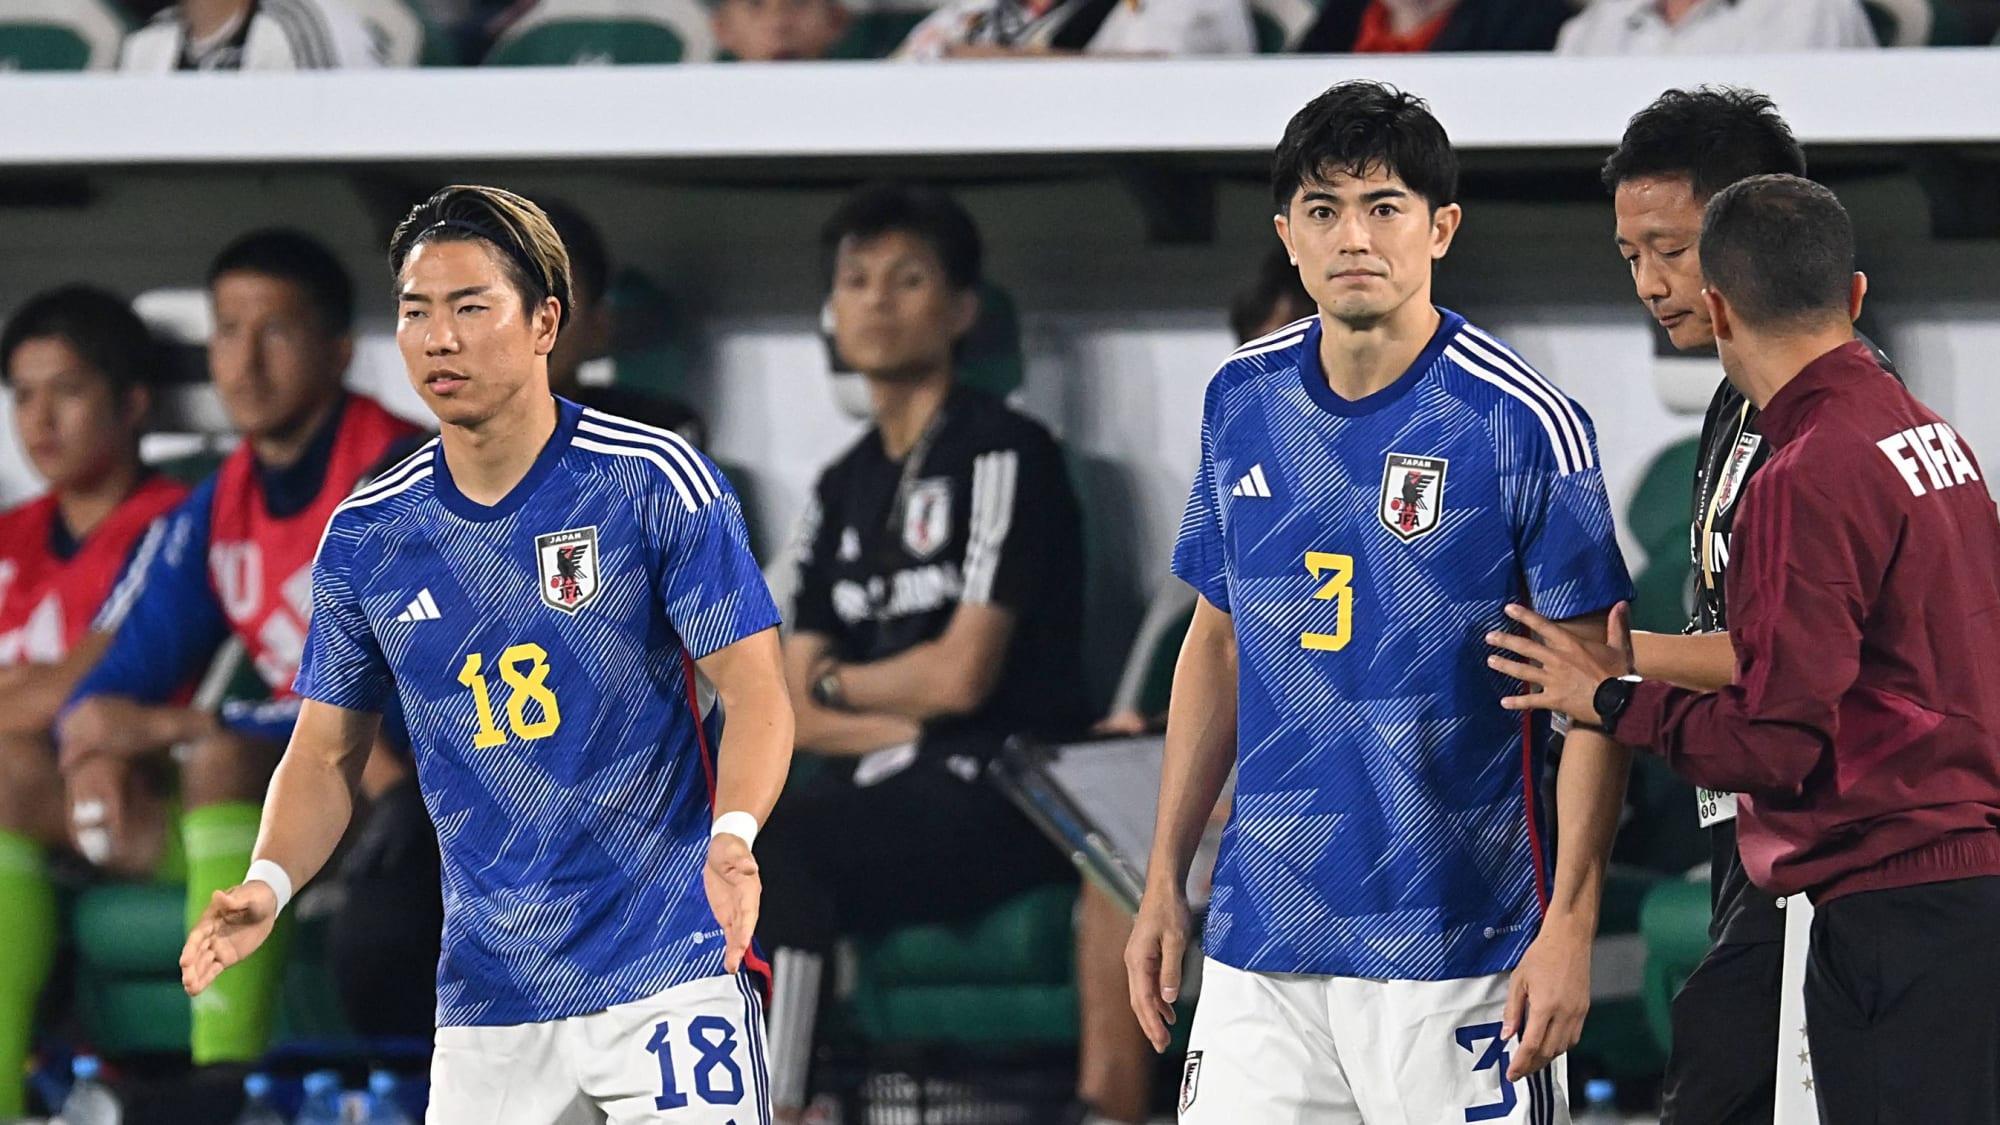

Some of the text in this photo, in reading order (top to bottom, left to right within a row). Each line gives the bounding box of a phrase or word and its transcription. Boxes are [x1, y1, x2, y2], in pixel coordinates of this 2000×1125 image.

[1401, 458, 1431, 468] JAPAN
[1876, 422, 1979, 497] FIFA
[550, 532, 581, 543] JAPAN
[1394, 513, 1420, 528] JFA
[557, 585, 583, 601] JFA
[1301, 551, 1353, 652] 3
[457, 642, 561, 750] 18
[645, 1015, 744, 1111] 18
[1455, 1021, 1518, 1123] 3
